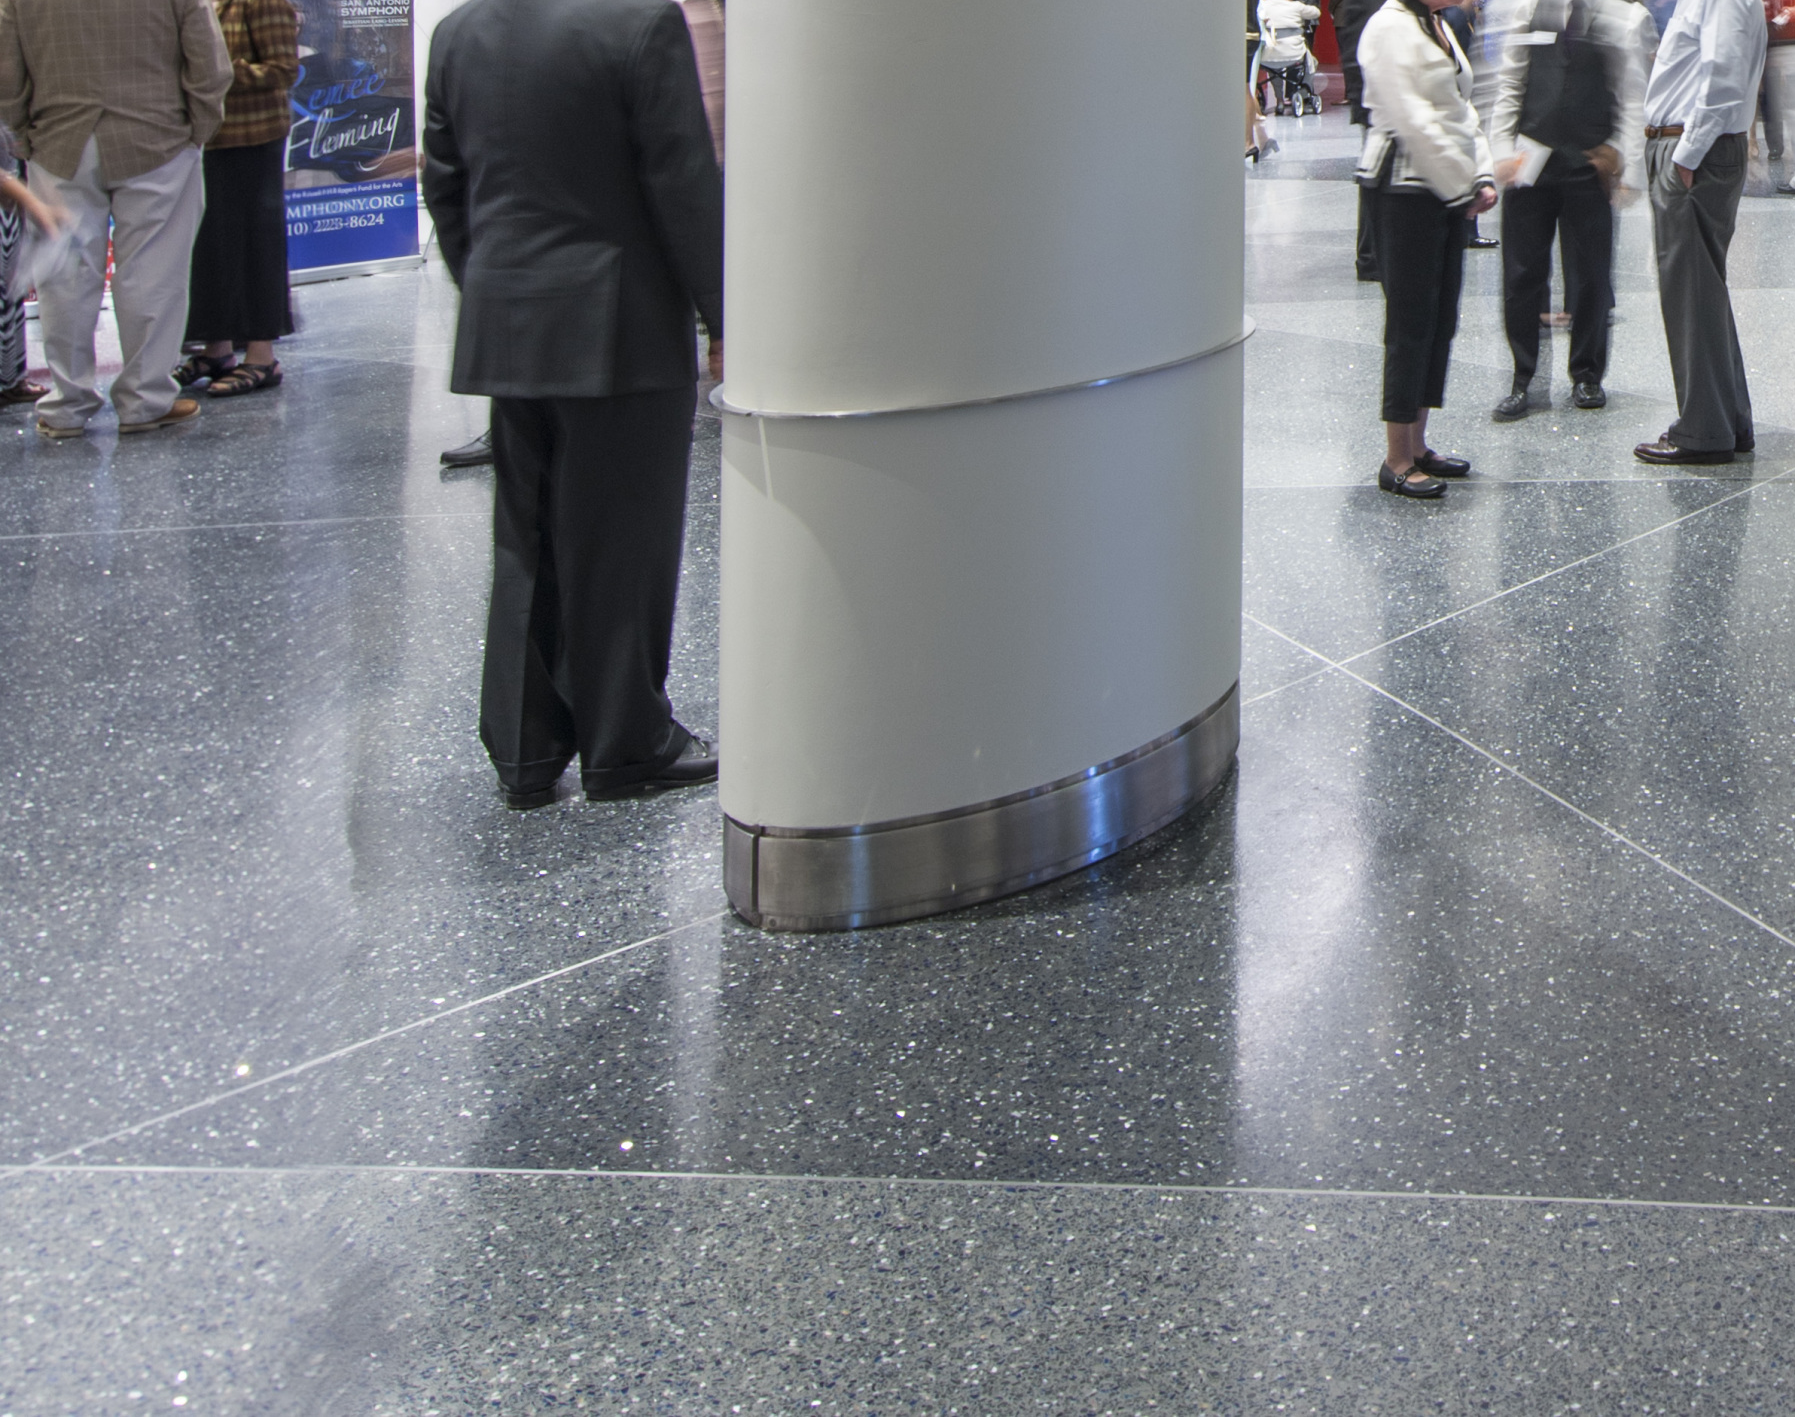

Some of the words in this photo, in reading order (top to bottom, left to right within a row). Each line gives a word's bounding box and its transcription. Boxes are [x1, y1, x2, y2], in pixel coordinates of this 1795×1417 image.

[341, 0, 362, 7] SAN
[341, 6, 410, 17] SYMPHONY
[286, 193, 405, 219] MPHONY.ORG
